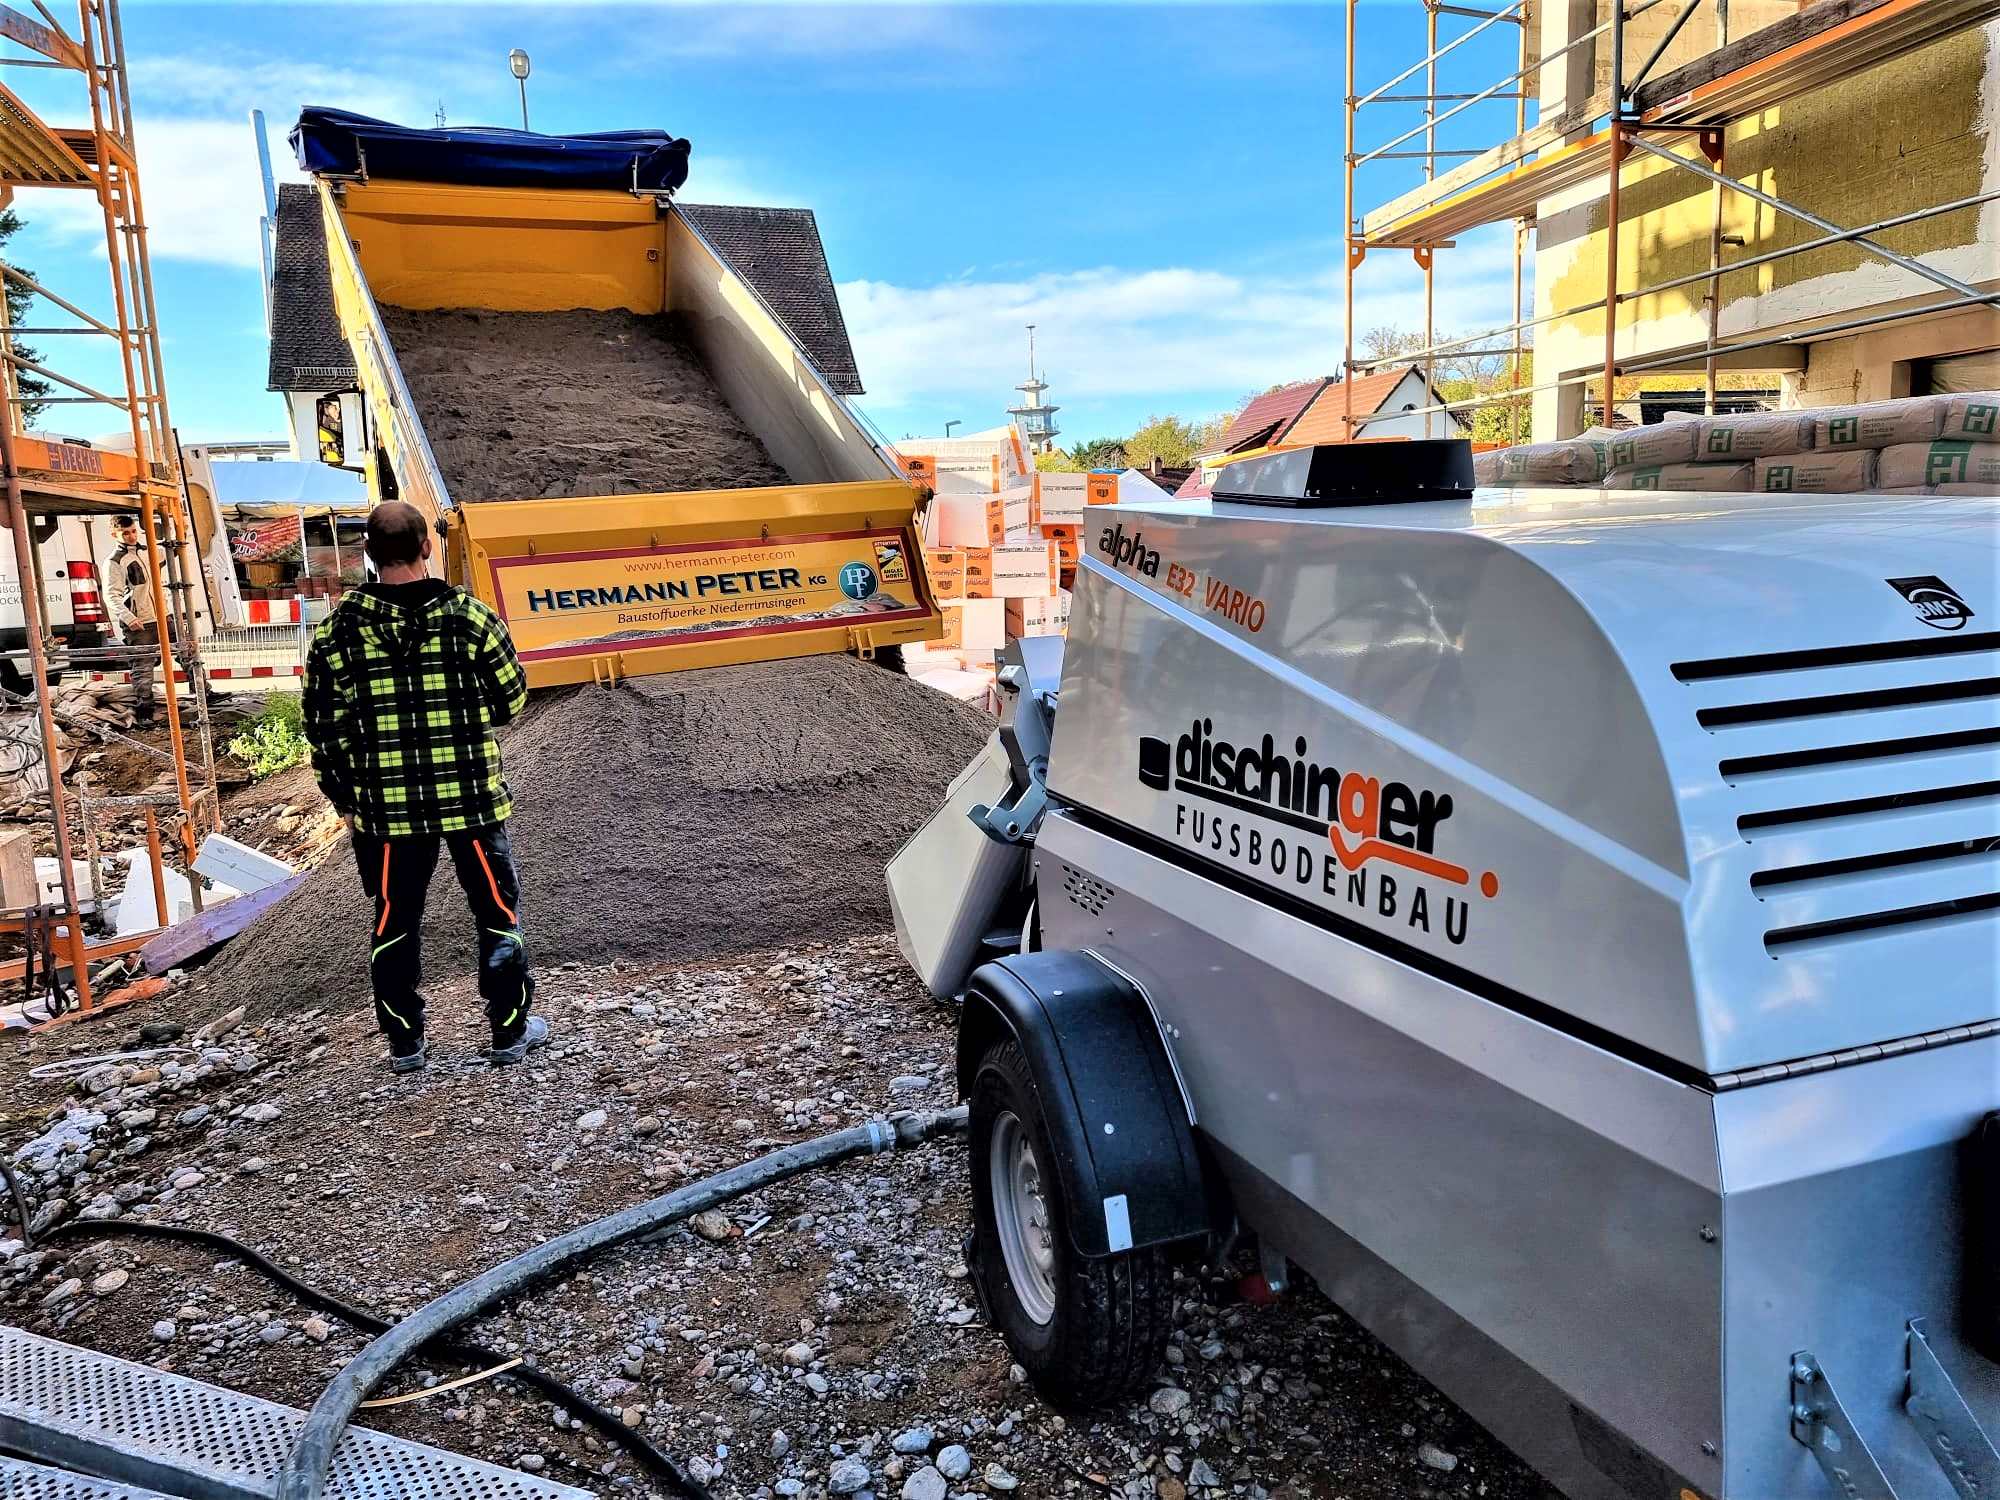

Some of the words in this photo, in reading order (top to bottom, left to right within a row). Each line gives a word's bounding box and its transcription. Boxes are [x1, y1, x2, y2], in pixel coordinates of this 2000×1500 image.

[624, 549, 796, 573] www.hermann-peter.com
[1099, 523, 1161, 578] alpha
[1166, 563, 1196, 598] E32
[1205, 576, 1265, 632] VARIO
[527, 580, 690, 612] HERMANN
[694, 567, 802, 598] PETER
[808, 575, 827, 586] KG
[617, 605, 707, 624] Baustoffwerke
[710, 596, 805, 616] Niederrimsingen
[1911, 599, 1960, 617] BMS
[1175, 718, 1453, 868] dischinger
[1176, 804, 1469, 945] FUSSBODENBAU
